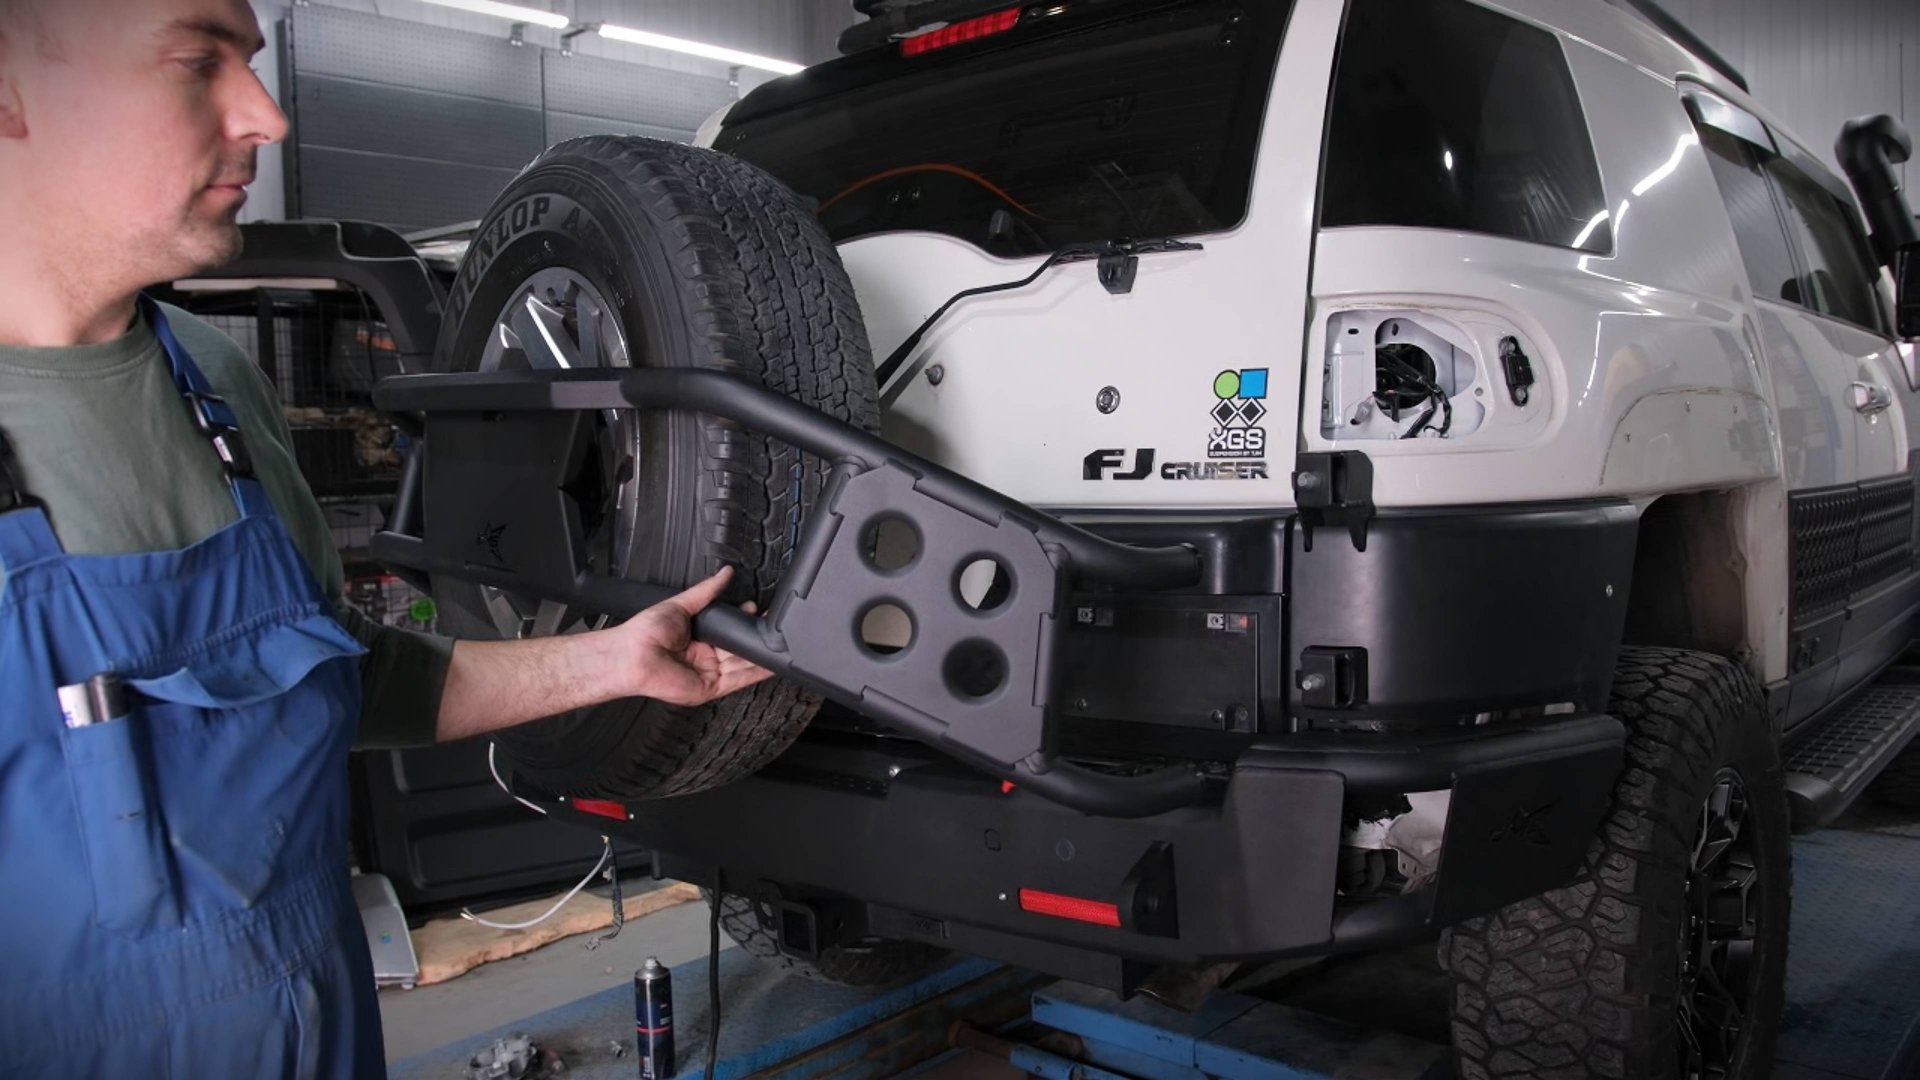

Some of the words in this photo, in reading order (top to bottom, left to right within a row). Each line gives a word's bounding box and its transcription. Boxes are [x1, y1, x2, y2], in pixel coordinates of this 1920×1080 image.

[453, 197, 550, 327] DUNLOP
[1209, 428, 1263, 450] XGS
[1083, 448, 1155, 480] FJ
[1160, 461, 1269, 480] CRUISER
